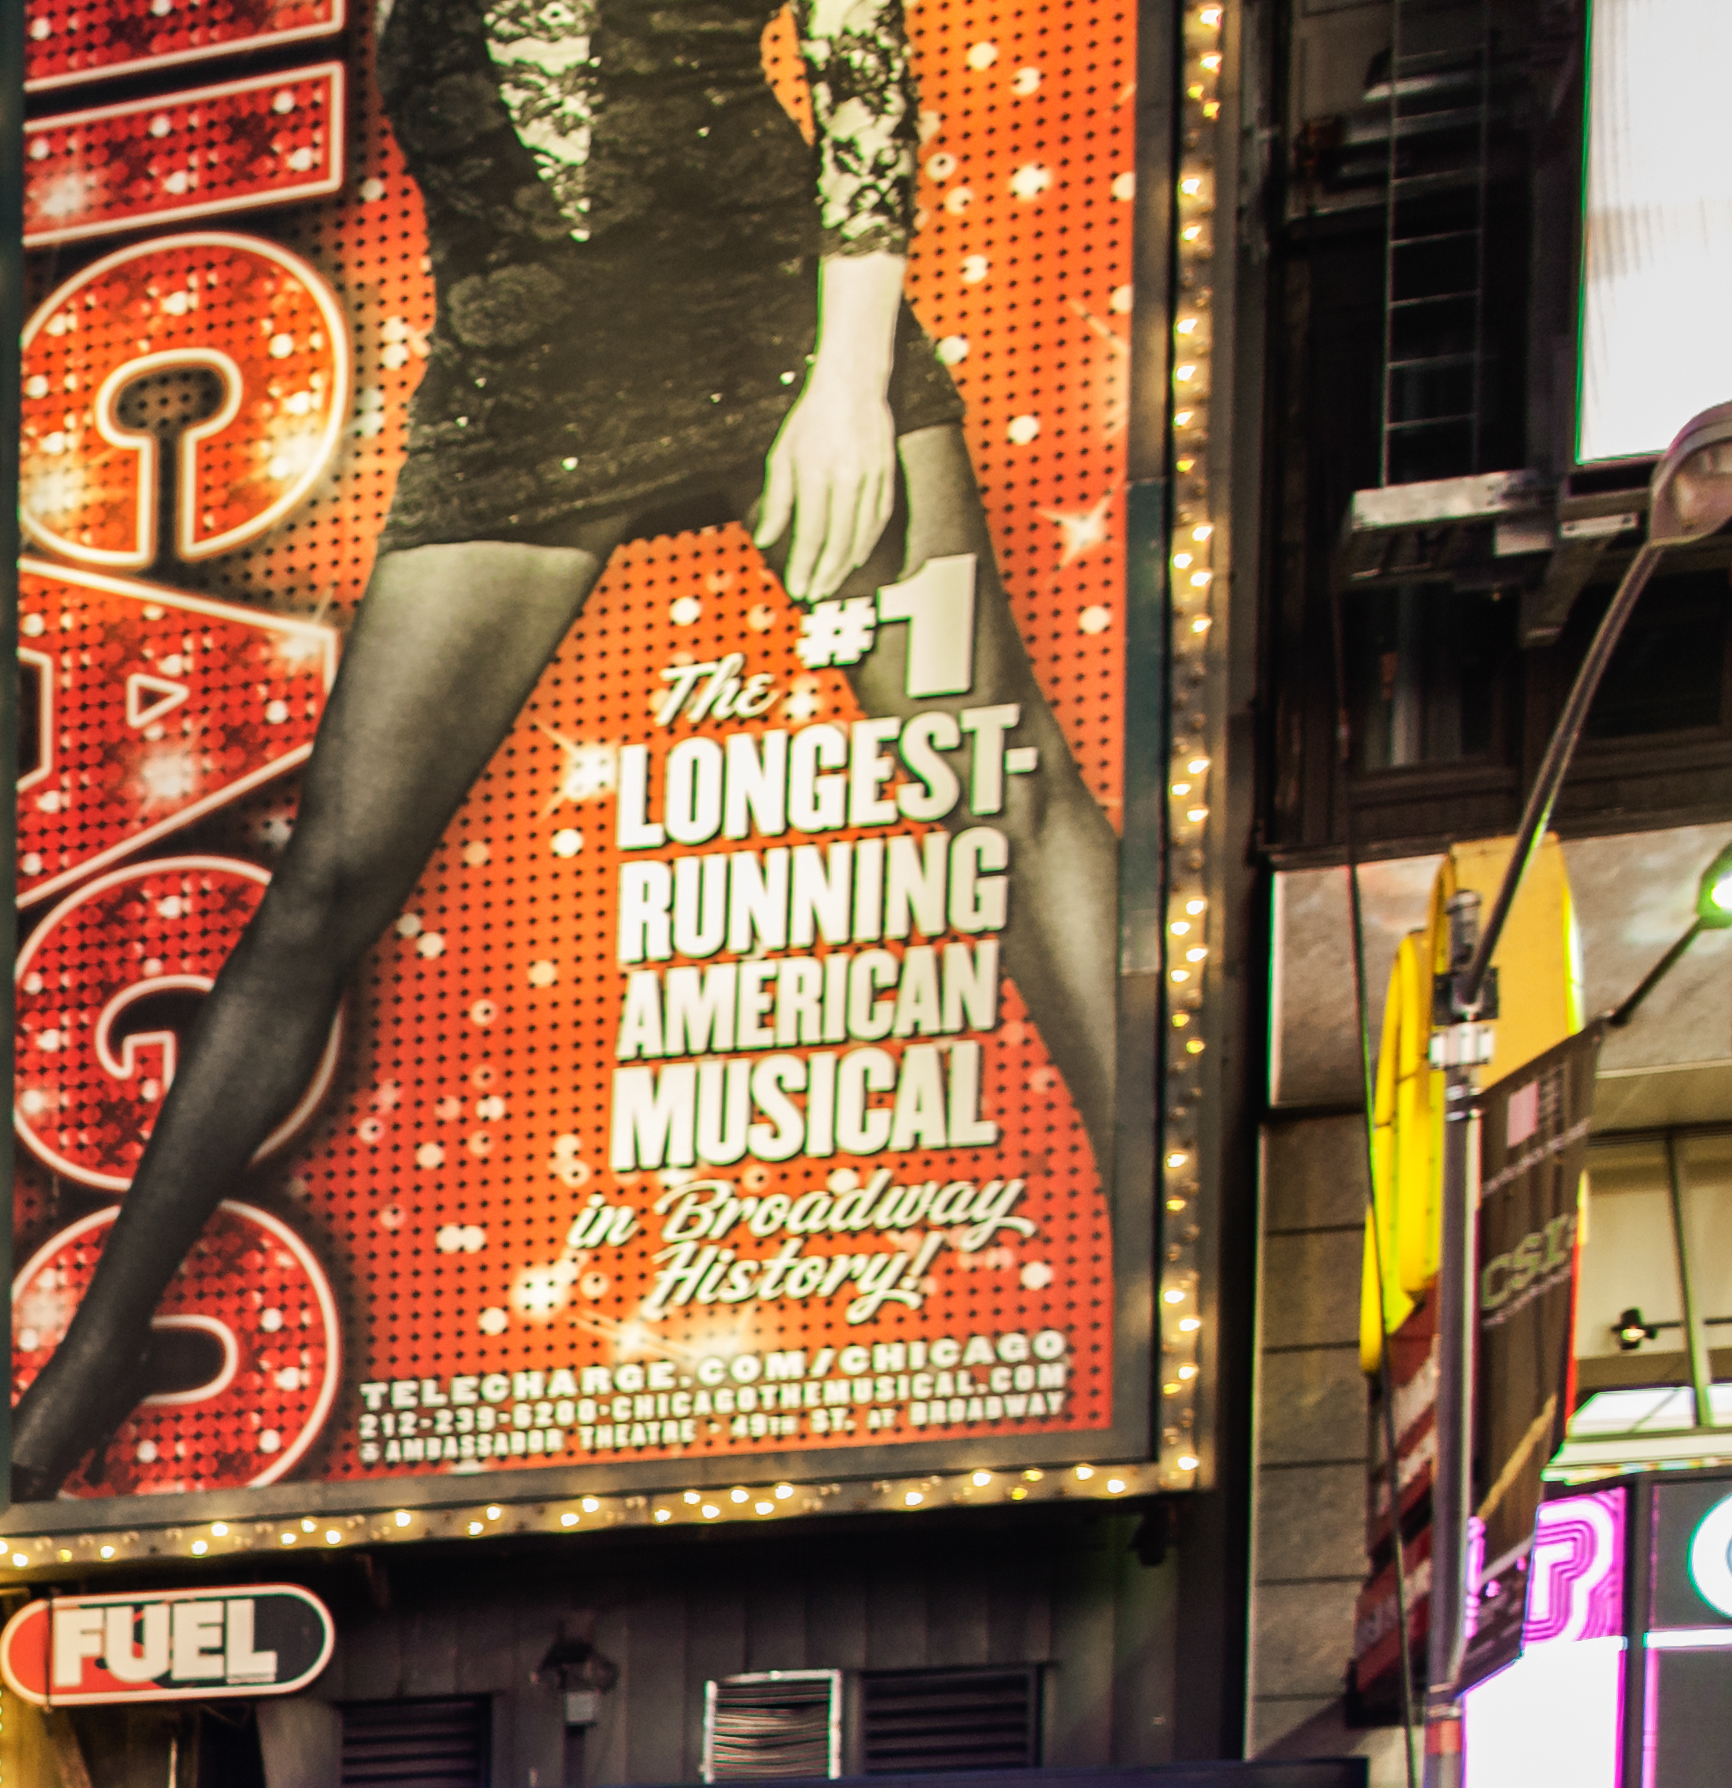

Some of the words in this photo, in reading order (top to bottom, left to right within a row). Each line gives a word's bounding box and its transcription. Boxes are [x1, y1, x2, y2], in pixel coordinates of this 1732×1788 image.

[653, 652, 783, 727] The
[795, 554, 977, 699] #1
[616, 703, 1037, 850] LONGEST-
[617, 826, 1010, 965] RUNNING
[616, 937, 1000, 1061] AMERICAN
[609, 1039, 998, 1172] MUSICAL
[565, 1192, 640, 1249] in
[655, 1166, 1038, 1248] Broadway
[640, 1230, 942, 1325] History!
[358, 1328, 1067, 1411] TELECHARGE.COM/CHICAGO
[386, 1428, 565, 1463] AMBASSADOR
[578, 1419, 698, 1451] THEATRE
[810, 1407, 857, 1434] ST.
[867, 1408, 897, 1430] AT
[909, 1390, 1066, 1427] BROADWAY
[52, 1598, 279, 1689] FUEL
